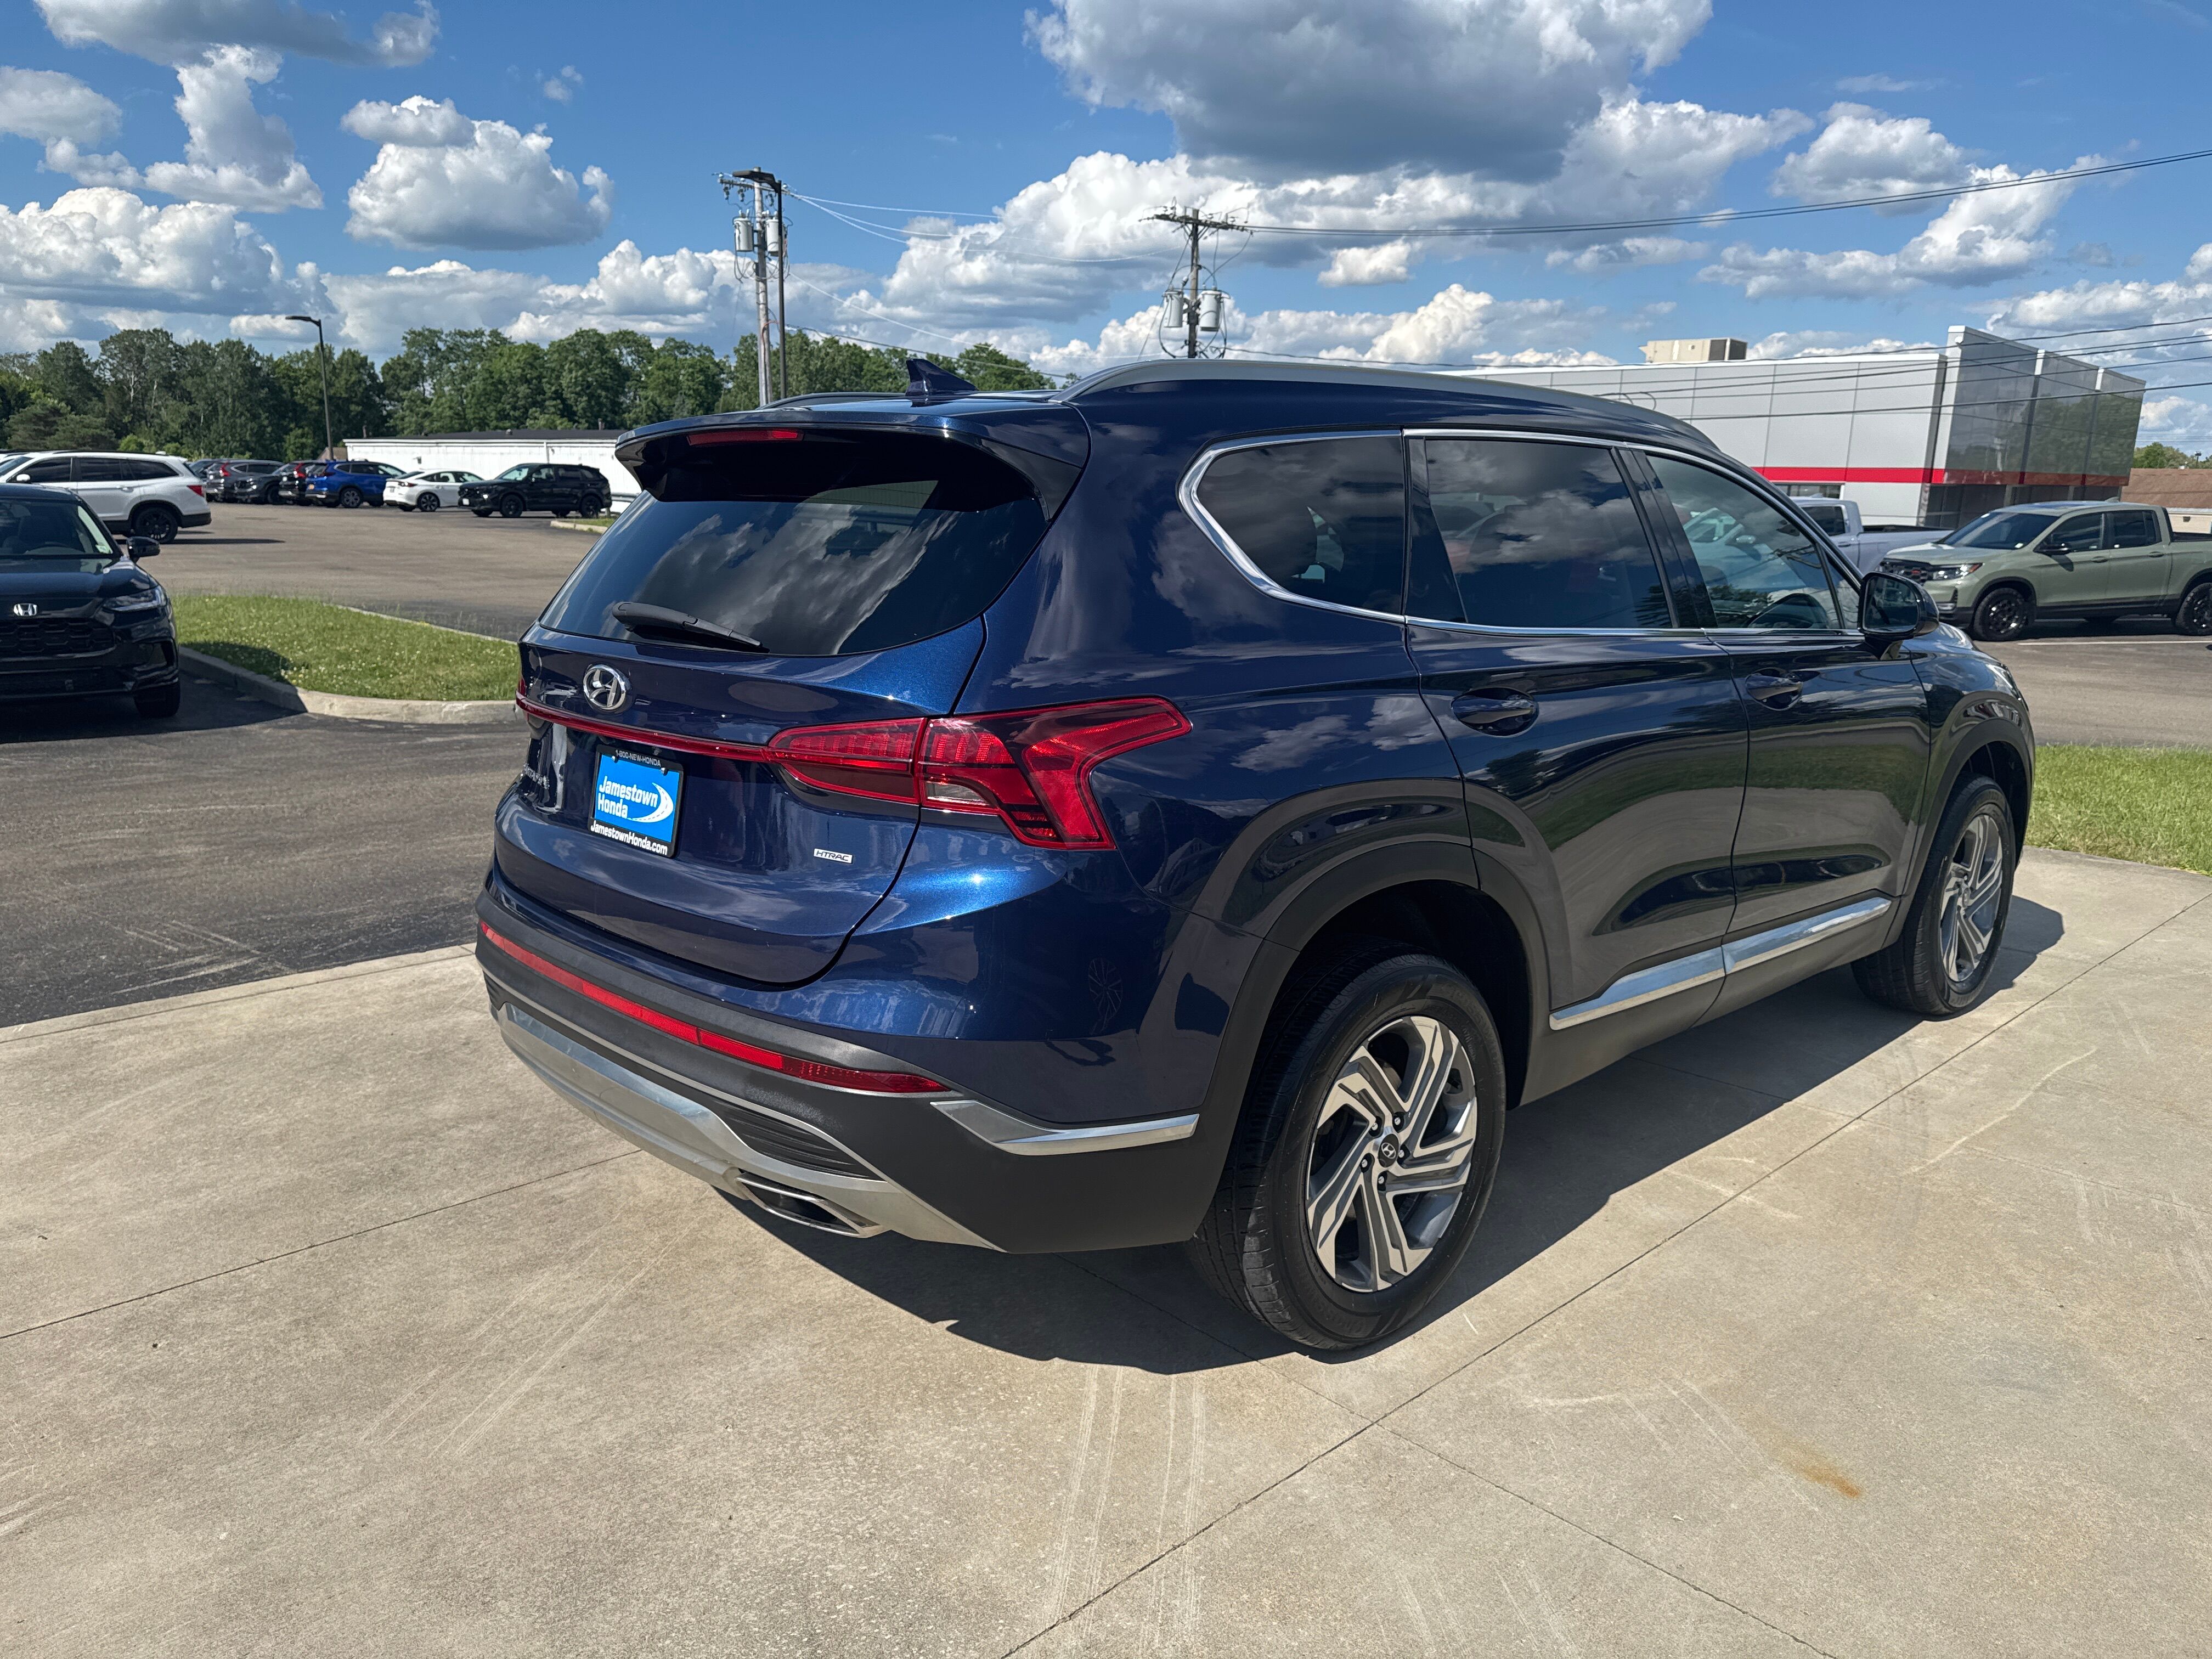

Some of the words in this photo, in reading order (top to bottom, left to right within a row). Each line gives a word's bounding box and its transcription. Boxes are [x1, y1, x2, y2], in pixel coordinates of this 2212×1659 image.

[615, 749, 661, 767] 1-800-NEW-HONDA
[599, 775, 658, 808] Jamestown
[597, 792, 628, 819] Honda
[590, 820, 668, 856] JamestownHonda.com
[816, 850, 849, 861] HTRAC
